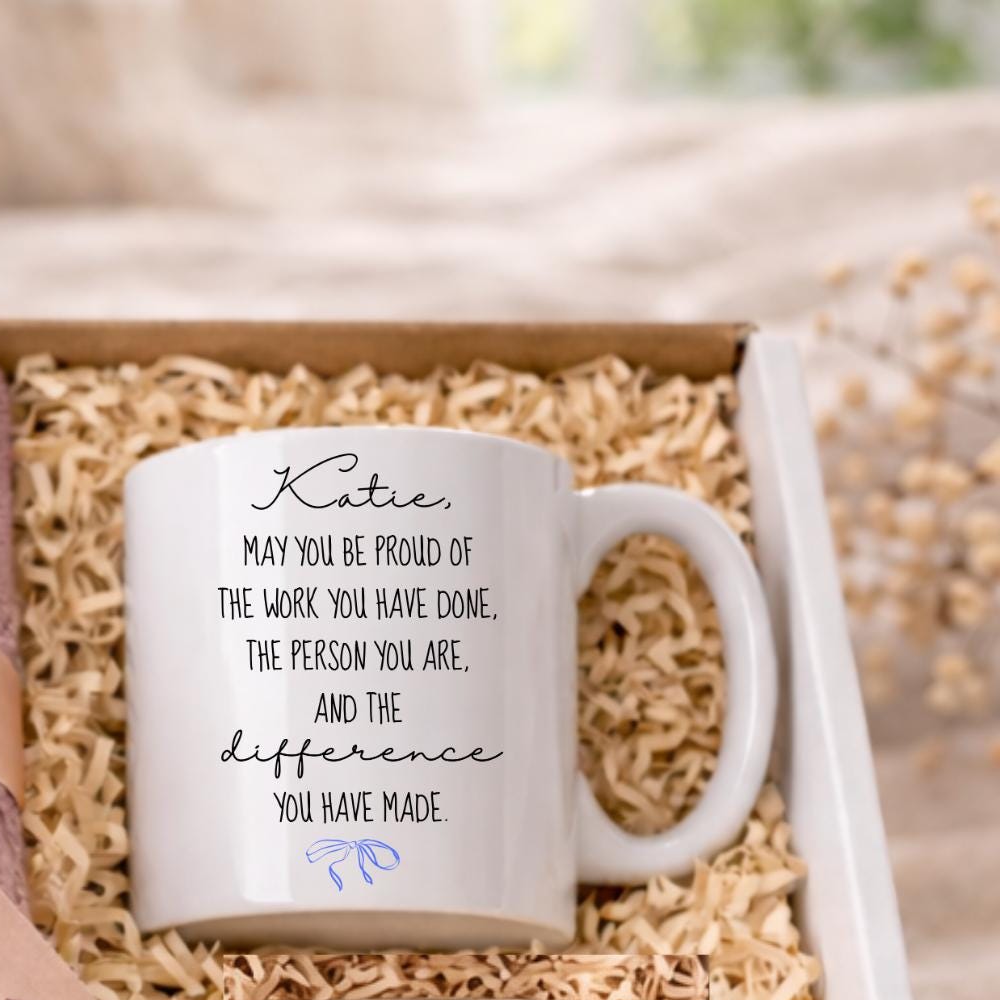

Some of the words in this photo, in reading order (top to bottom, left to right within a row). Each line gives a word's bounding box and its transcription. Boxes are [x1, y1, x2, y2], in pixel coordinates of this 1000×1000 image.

[251, 452, 452, 511] Katie,
[243, 534, 288, 567] MAY
[294, 534, 335, 567] YOU
[342, 534, 367, 567] BE
[375, 534, 442, 568] PROUD
[449, 535, 473, 567] OF
[217, 586, 255, 621] THE
[263, 586, 320, 619] WORK
[327, 586, 368, 619] YOU
[375, 586, 429, 621] HAVE
[437, 586, 498, 621] DONE,
[245, 639, 283, 673] THE
[291, 639, 367, 672] PERSON
[373, 639, 414, 672] YOU
[422, 639, 469, 673] ARE,
[313, 692, 358, 725] AND
[365, 691, 403, 725] THE
[220, 729, 504, 780] difference
[273, 790, 314, 823] YOU
[321, 790, 374, 824] HAVE
[382, 790, 448, 824] MADE.
